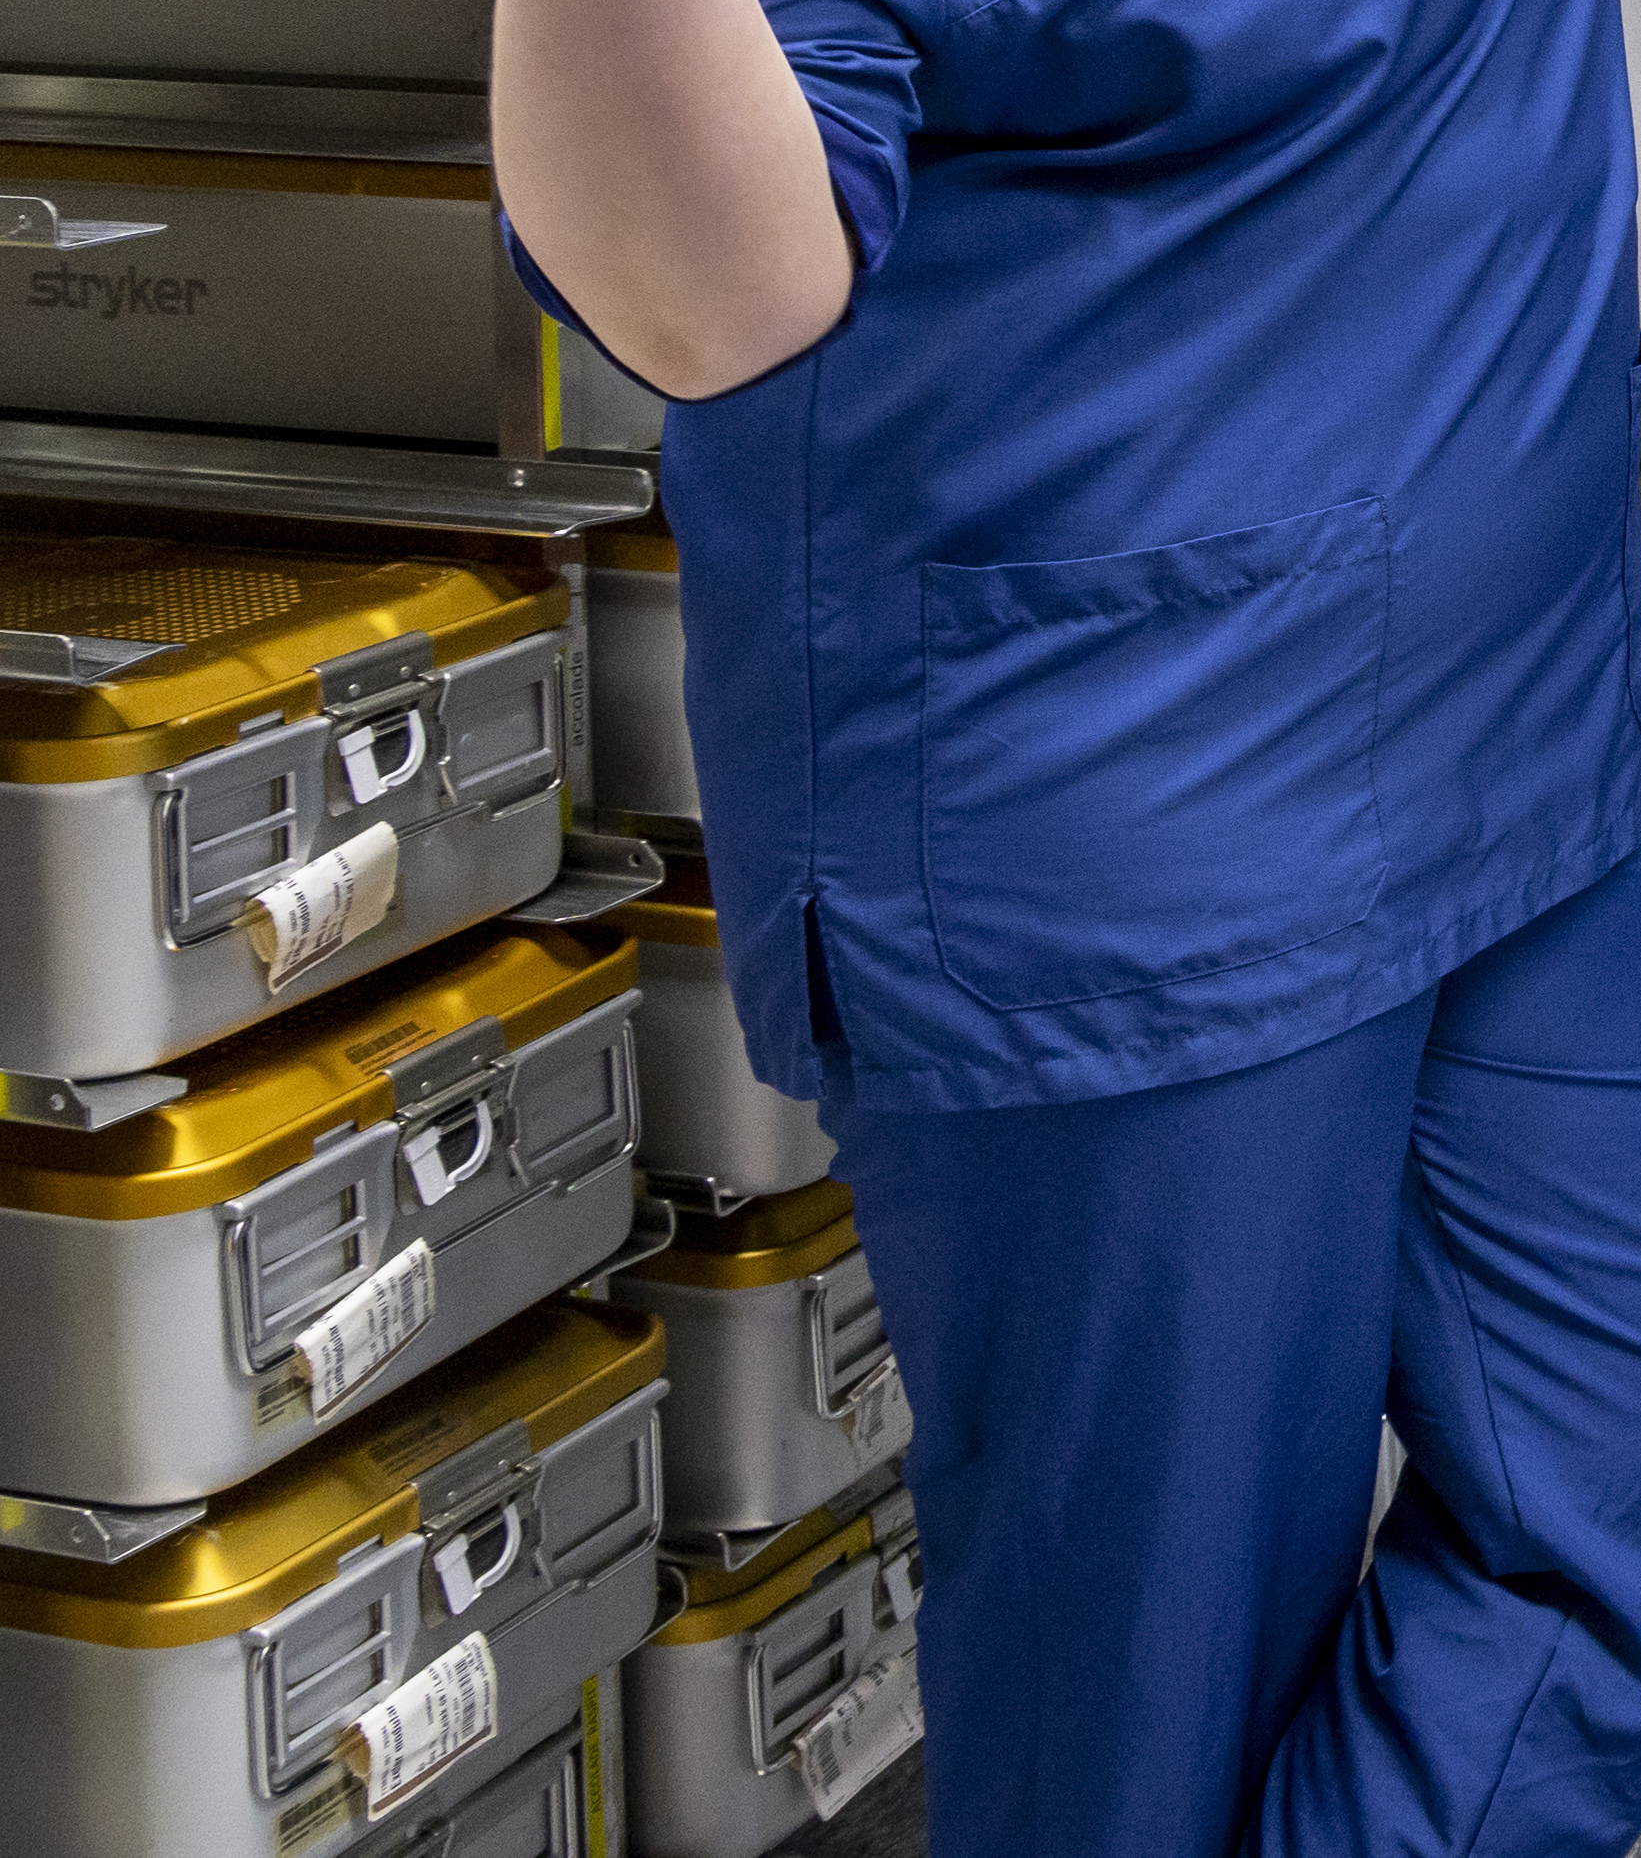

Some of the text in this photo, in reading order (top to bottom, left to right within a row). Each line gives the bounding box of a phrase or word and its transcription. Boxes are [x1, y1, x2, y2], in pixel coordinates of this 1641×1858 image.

[26, 262, 208, 319] stryker
[569, 651, 584, 747] accolade
[384, 1704, 404, 1752] modular
